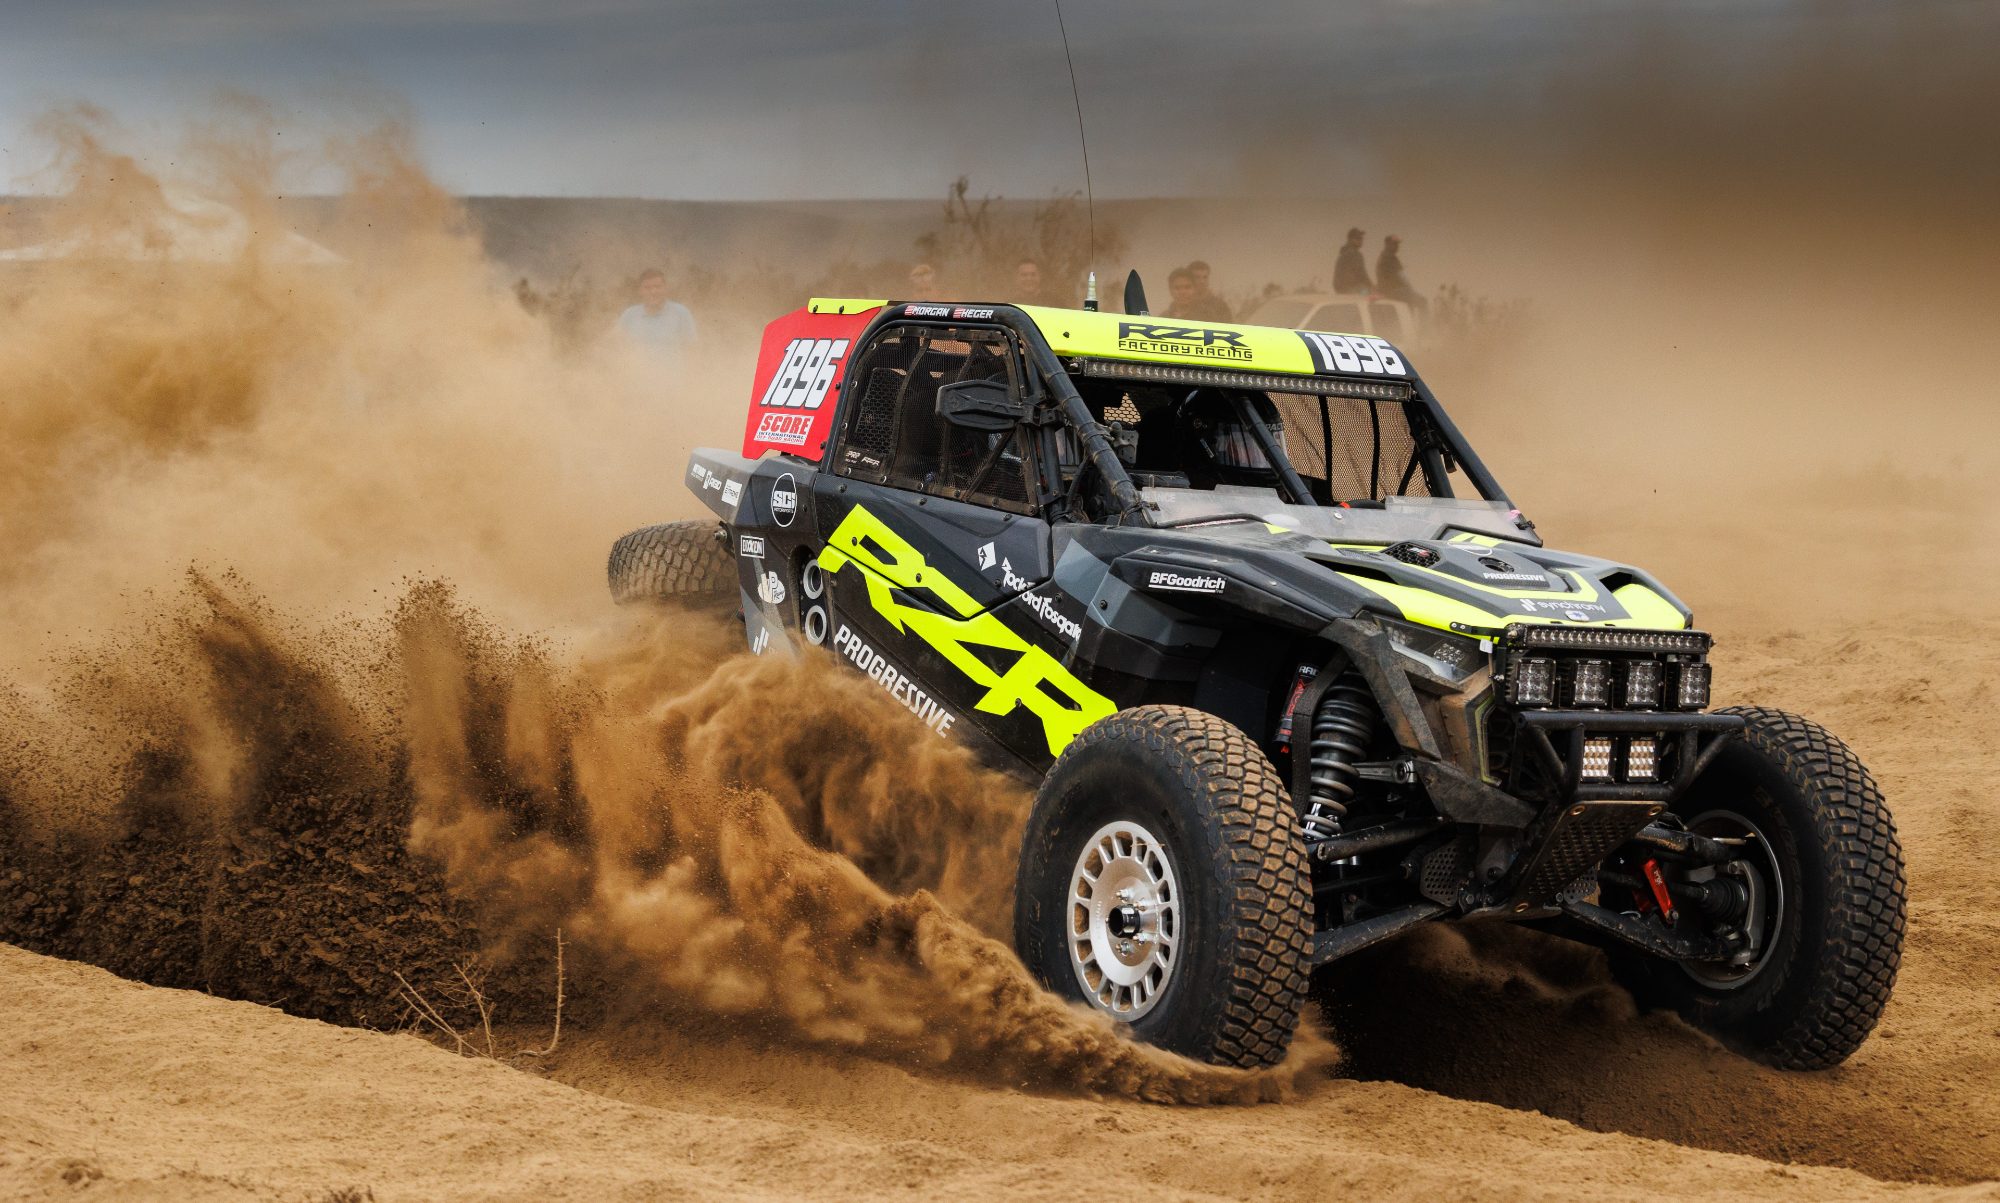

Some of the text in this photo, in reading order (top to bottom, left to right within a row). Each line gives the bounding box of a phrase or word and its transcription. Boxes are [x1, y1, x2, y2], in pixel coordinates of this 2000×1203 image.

[911, 306, 994, 319] MORGAN HEGER
[1118, 322, 1249, 347] RZR
[1118, 340, 1190, 354] FACTORY
[1304, 332, 1406, 376] 1896
[759, 338, 851, 410] 1896
[760, 415, 811, 435] SCORE
[758, 432, 804, 440] INTERNATIONAL
[1149, 572, 1226, 589] BFGoodrich
[1482, 572, 1546, 582] PROGRESSIVE
[817, 503, 1118, 759] RZR
[833, 624, 956, 738] PROGRESSIVE
